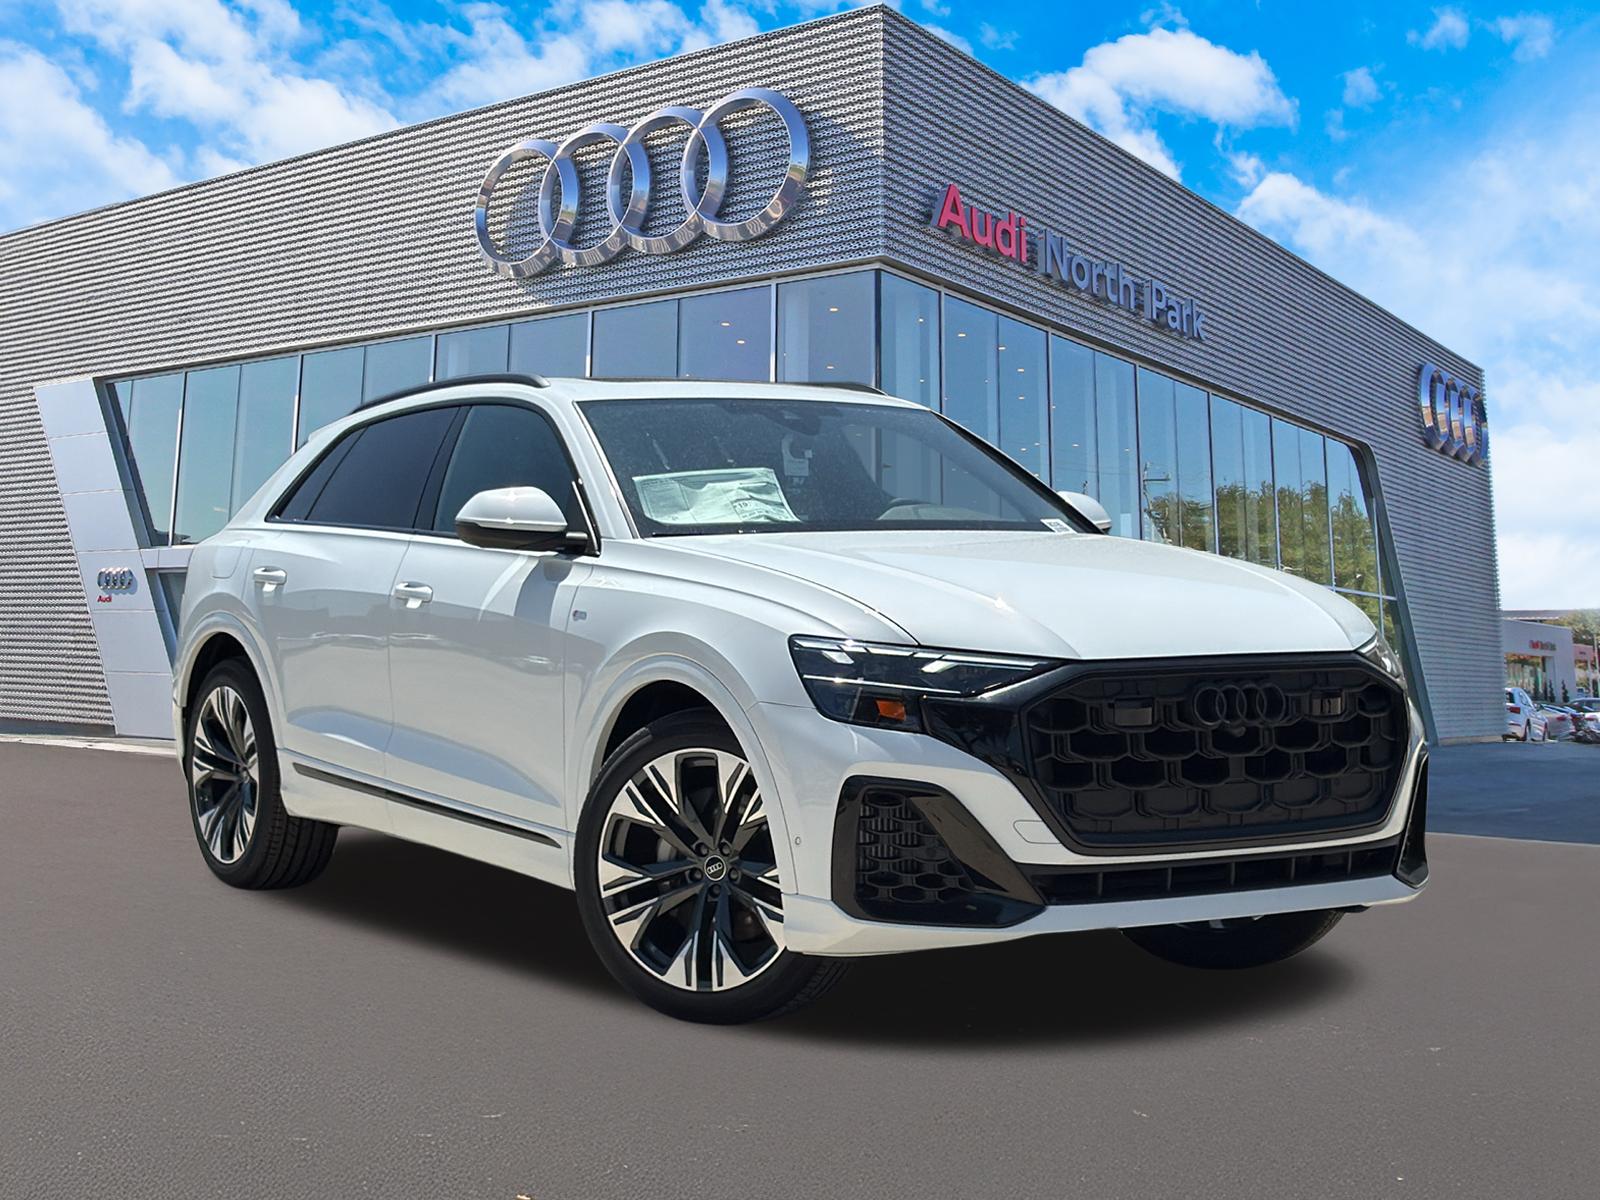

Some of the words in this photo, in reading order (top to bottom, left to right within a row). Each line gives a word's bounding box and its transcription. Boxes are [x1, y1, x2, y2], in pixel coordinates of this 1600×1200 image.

[932, 183, 1027, 262] Audi
[1040, 229, 1136, 312] North
[1146, 279, 1207, 341] Park
